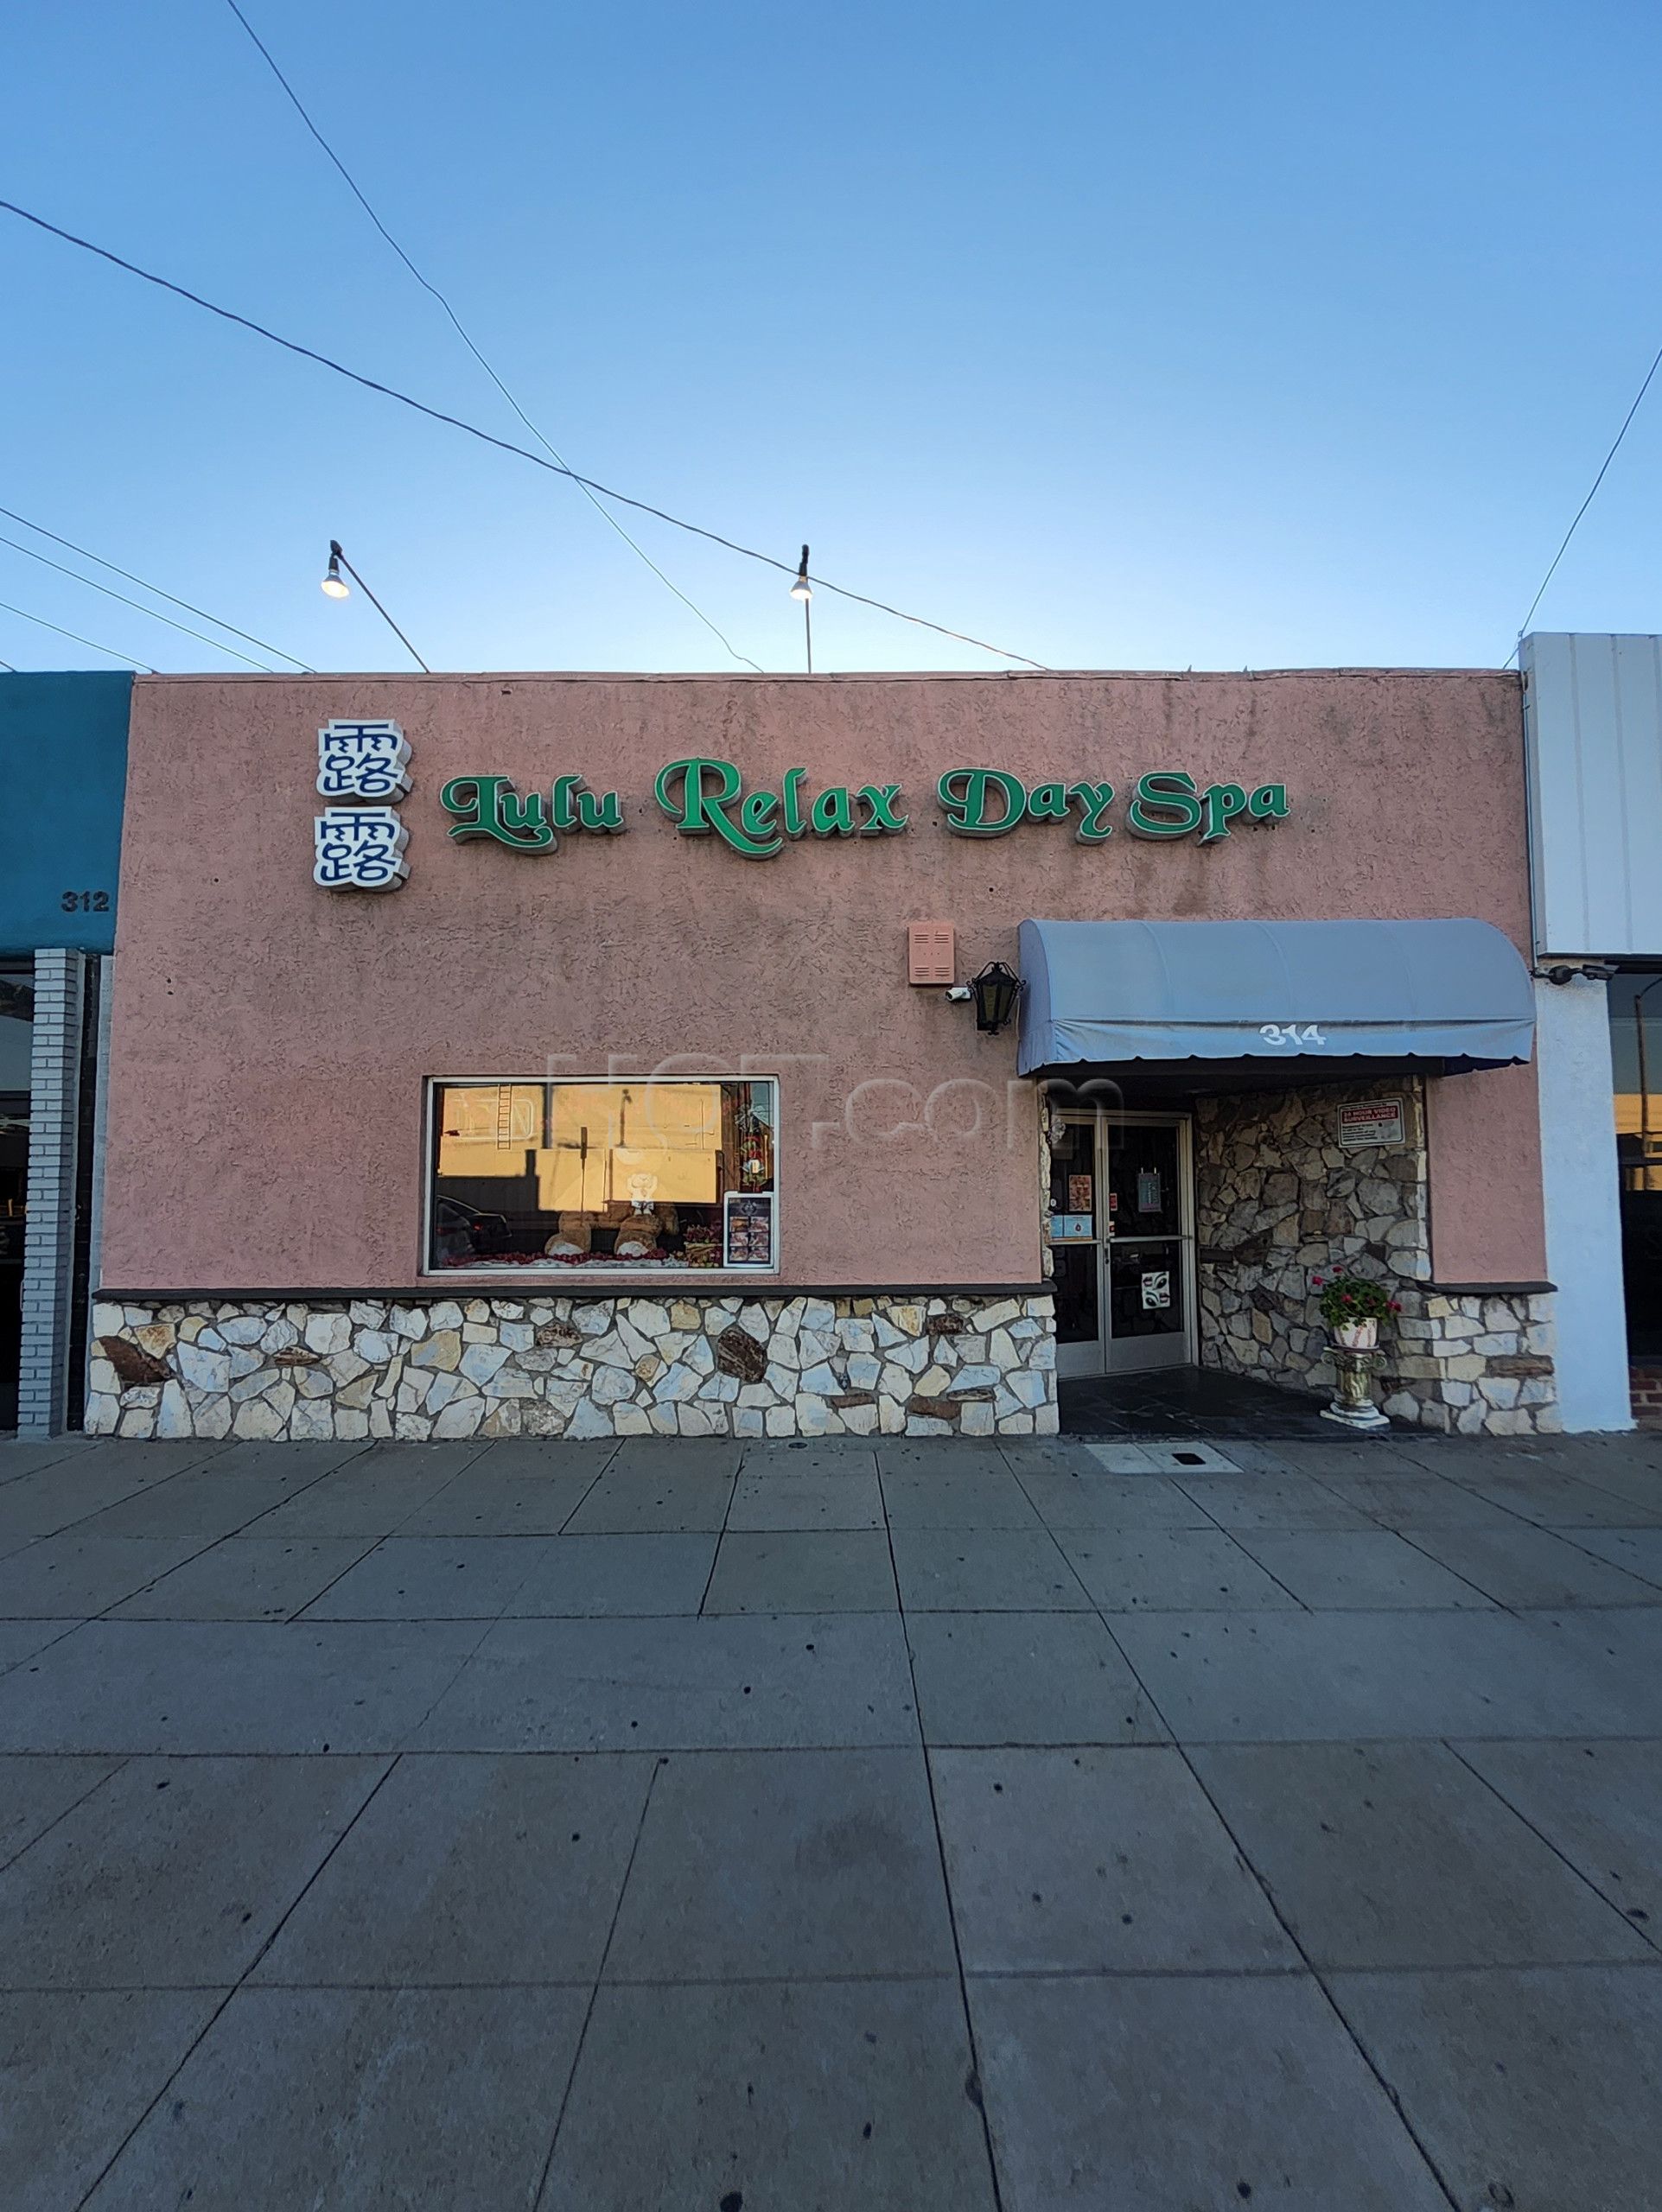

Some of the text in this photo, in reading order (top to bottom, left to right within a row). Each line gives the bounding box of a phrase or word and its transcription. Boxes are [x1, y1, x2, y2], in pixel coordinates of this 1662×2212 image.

[440, 757, 1291, 856] Lulu Relax Day Spa
[60, 890, 111, 913] 312
[1258, 1023, 1328, 1046] 314
[1343, 1112, 1397, 1122] SURVEILLANCE
